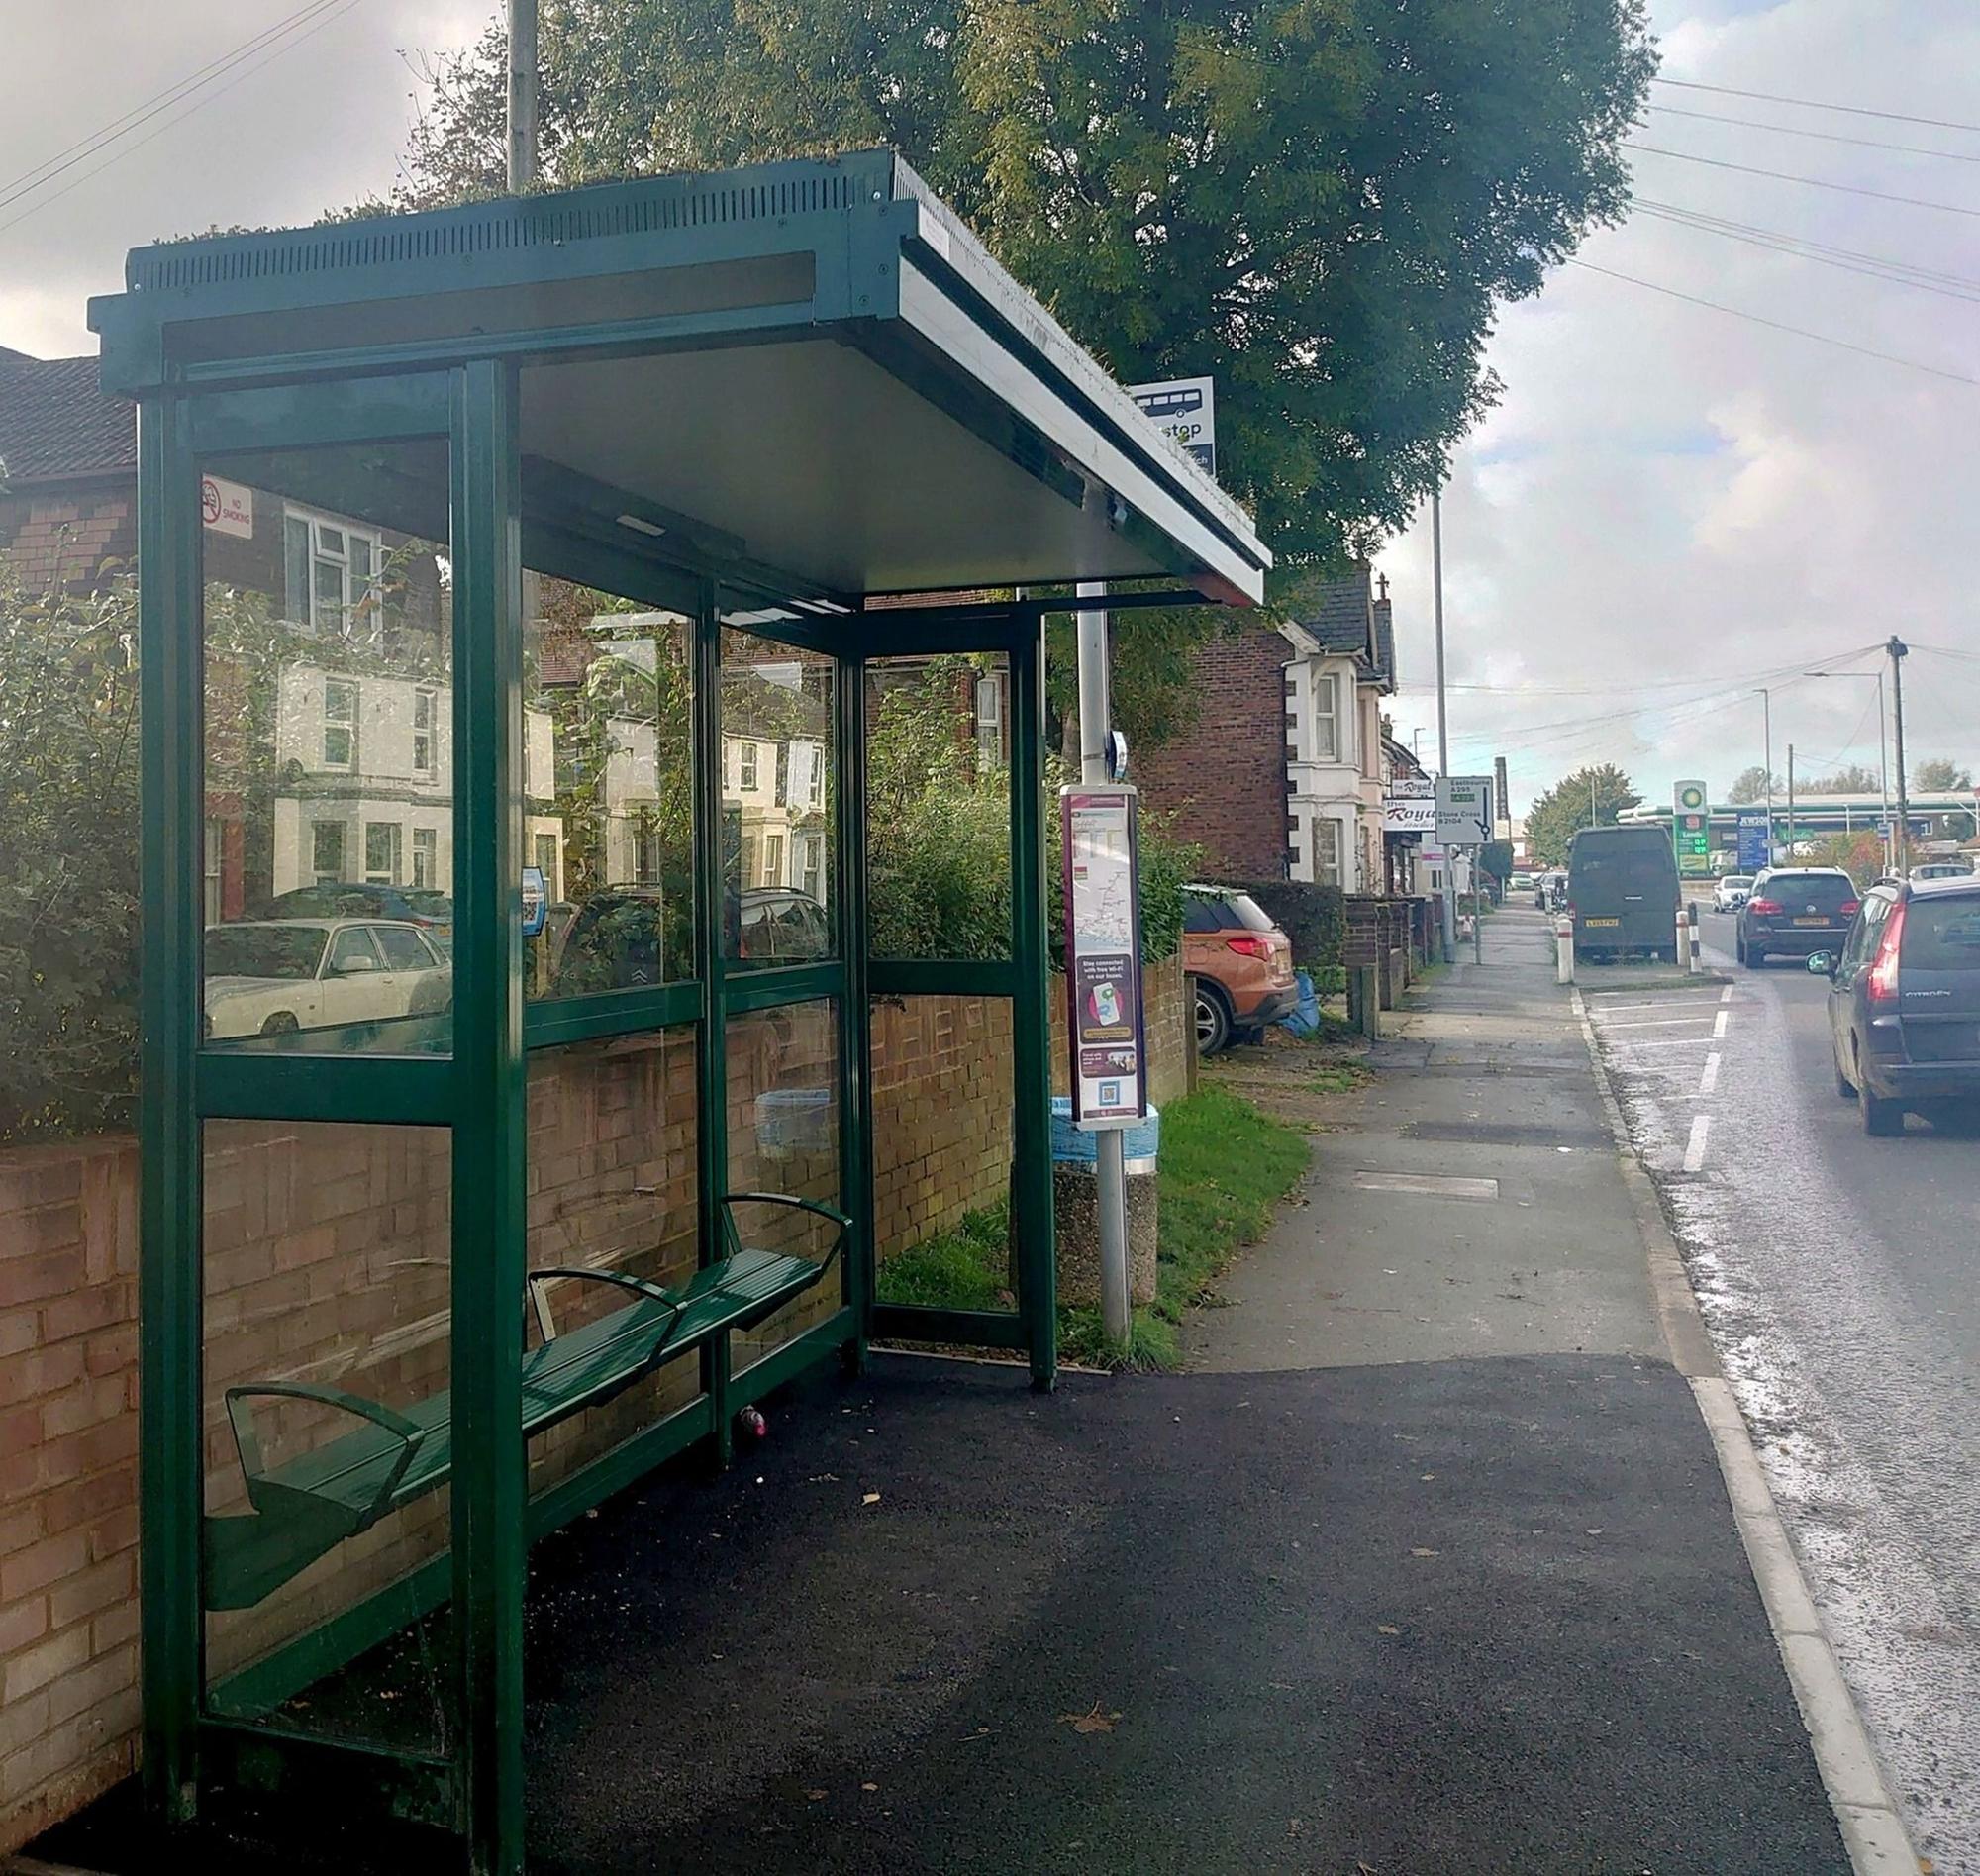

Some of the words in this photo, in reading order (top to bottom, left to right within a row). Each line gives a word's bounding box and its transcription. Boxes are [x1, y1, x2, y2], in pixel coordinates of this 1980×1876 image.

[1161, 424, 1201, 438] stop
[232, 498, 242, 509] NO
[223, 508, 250, 525] SMOKING
[1404, 781, 1432, 793] Royal
[1387, 808, 1436, 822] Roya
